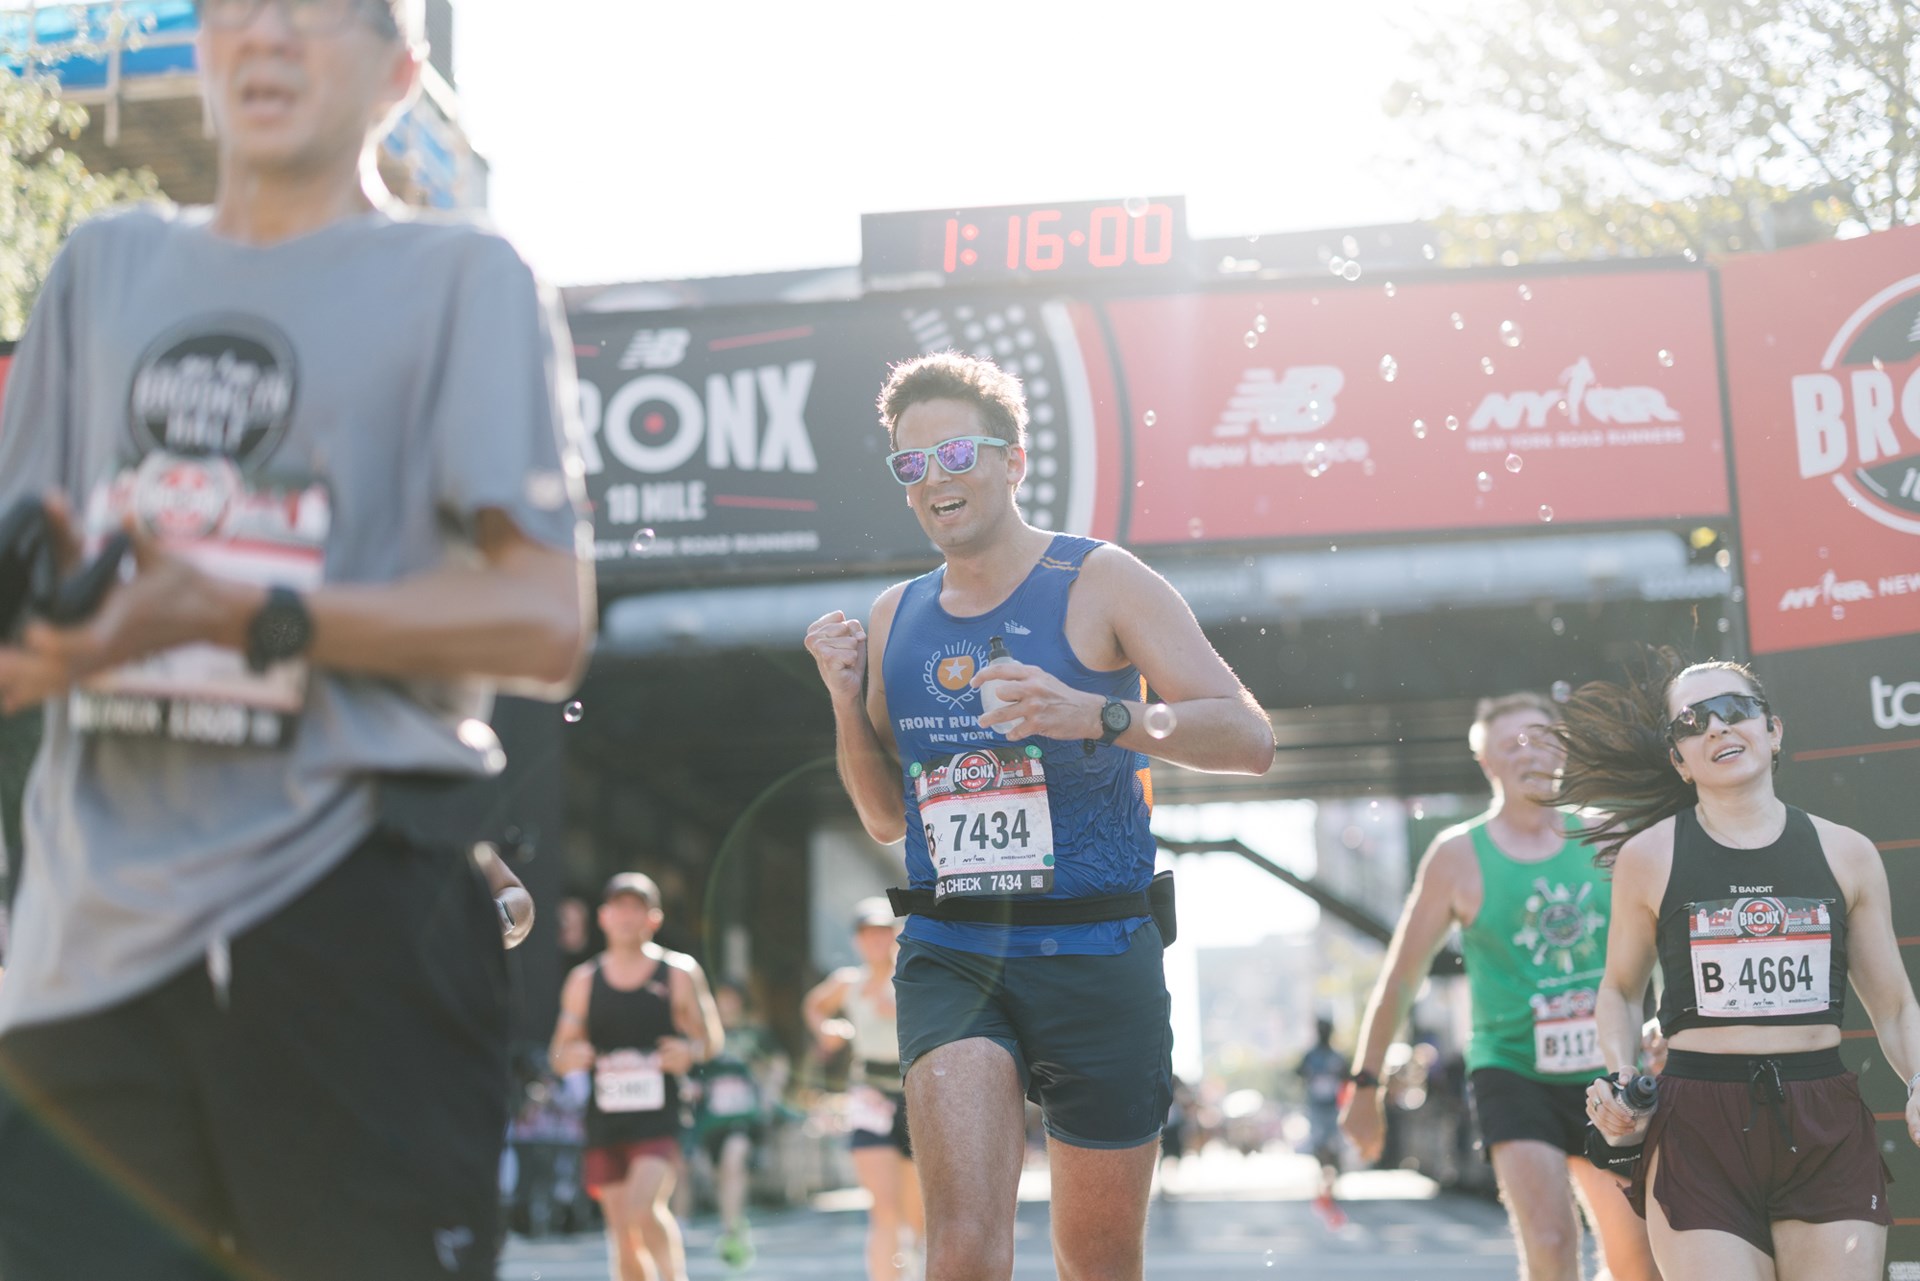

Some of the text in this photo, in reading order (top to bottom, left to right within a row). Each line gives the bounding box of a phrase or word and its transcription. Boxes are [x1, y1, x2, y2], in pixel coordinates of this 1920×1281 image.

[578, 359, 818, 475] RONX
[1791, 365, 1920, 480] BR
[605, 480, 707, 524] 10 MILE
[899, 716, 981, 731] FRONT RUN
[929, 731, 994, 743] NEW YORK
[954, 763, 994, 782] BRONX
[950, 809, 1030, 851] 7434
[946, 877, 982, 894] CHECK
[990, 874, 1022, 891] 7434
[1738, 885, 1773, 894] BANDIT
[1739, 910, 1780, 926] BRONX
[1701, 955, 1813, 994] B 4664
[1544, 1030, 1596, 1057] B117
